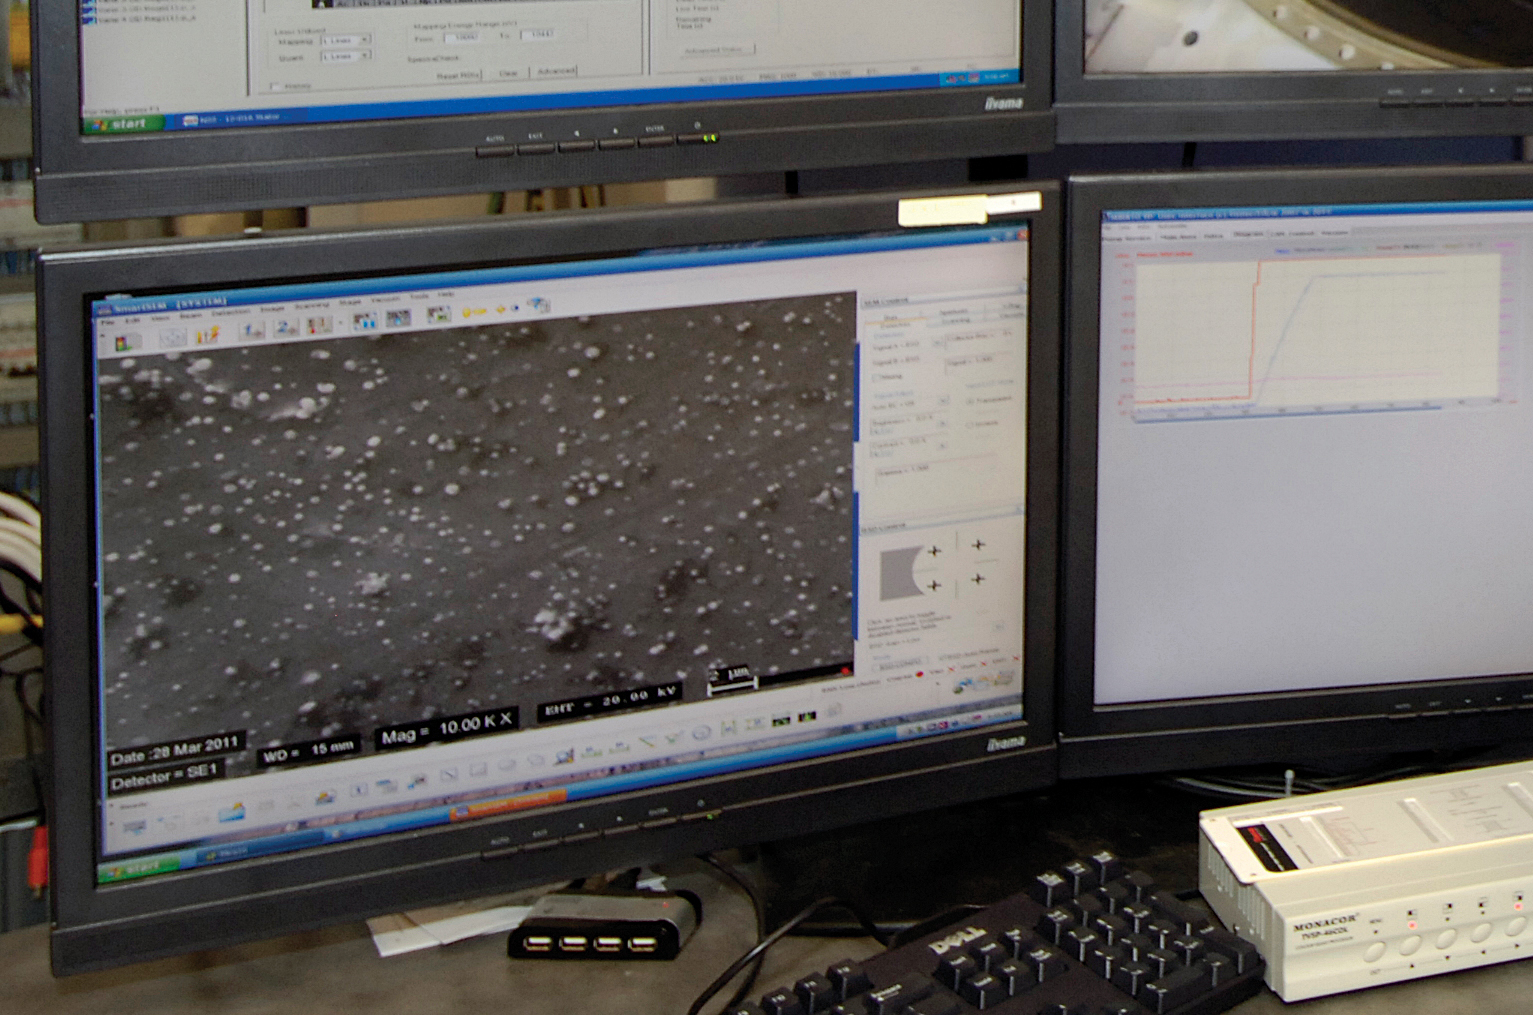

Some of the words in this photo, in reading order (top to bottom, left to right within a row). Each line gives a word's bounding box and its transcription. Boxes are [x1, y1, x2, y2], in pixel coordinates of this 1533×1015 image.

[112, 118, 147, 131] start
[603, 690, 649, 707] 20.00
[657, 685, 677, 697] kV
[382, 729, 417, 745] Mag
[420, 727, 429, 736] =
[440, 716, 481, 735] 10.00
[484, 714, 496, 728] K
[500, 711, 512, 725] X
[110, 749, 146, 768] Date
[173, 741, 201, 757] Mar
[204, 735, 239, 752] 2011
[263, 749, 289, 764] WD
[312, 742, 328, 756] 15
[331, 739, 355, 753] mm
[111, 771, 172, 791] Detector
[186, 763, 218, 779] SE1
[928, 926, 987, 955] DELL
